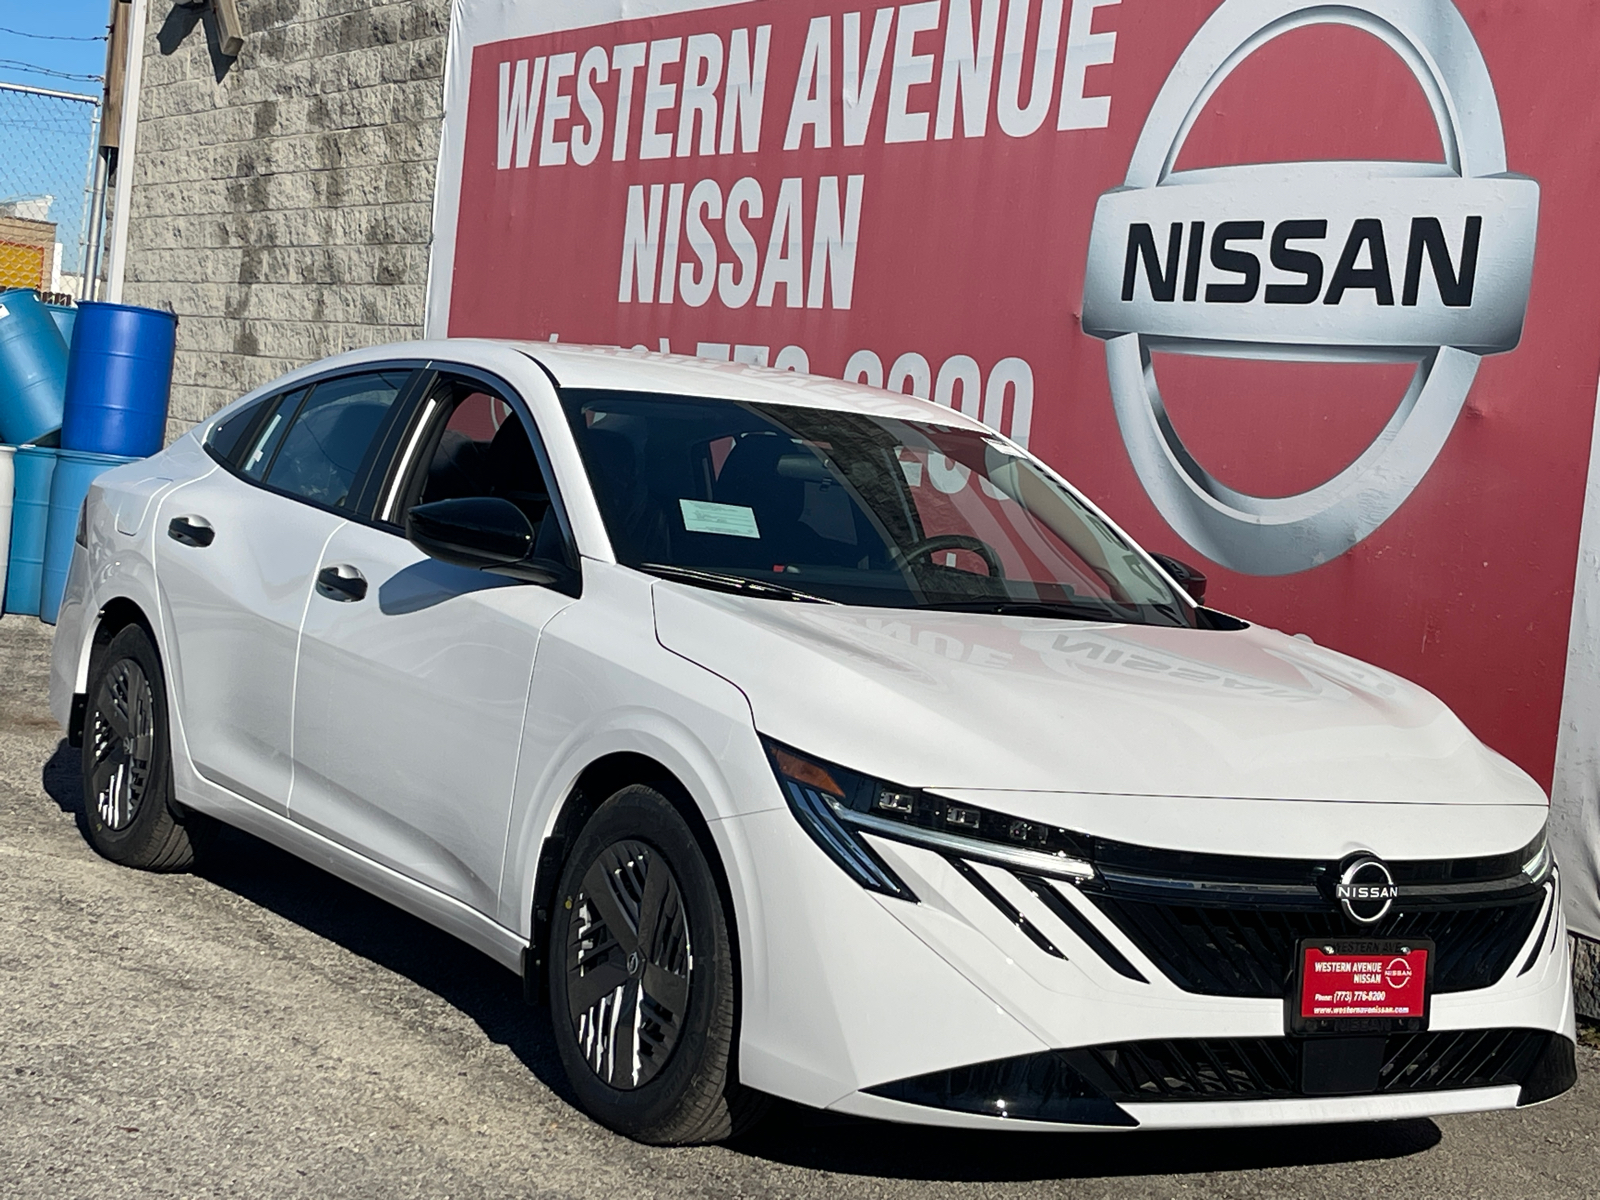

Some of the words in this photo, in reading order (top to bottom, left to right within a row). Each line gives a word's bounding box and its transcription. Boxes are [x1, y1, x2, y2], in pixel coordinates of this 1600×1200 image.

[497, 24, 772, 170] WESTERN
[784, 0, 1122, 151] AVENUE
[618, 174, 865, 310] NISSAN
[1121, 215, 1482, 307] NISSAN
[1338, 886, 1398, 898] NISSAN
[1315, 962, 1351, 972] WESTERN
[1352, 962, 1382, 972] AVENUE
[1354, 974, 1381, 983] NISSAN
[1333, 991, 1352, 1003] (773)
[1354, 991, 1386, 1001] 776-8200
